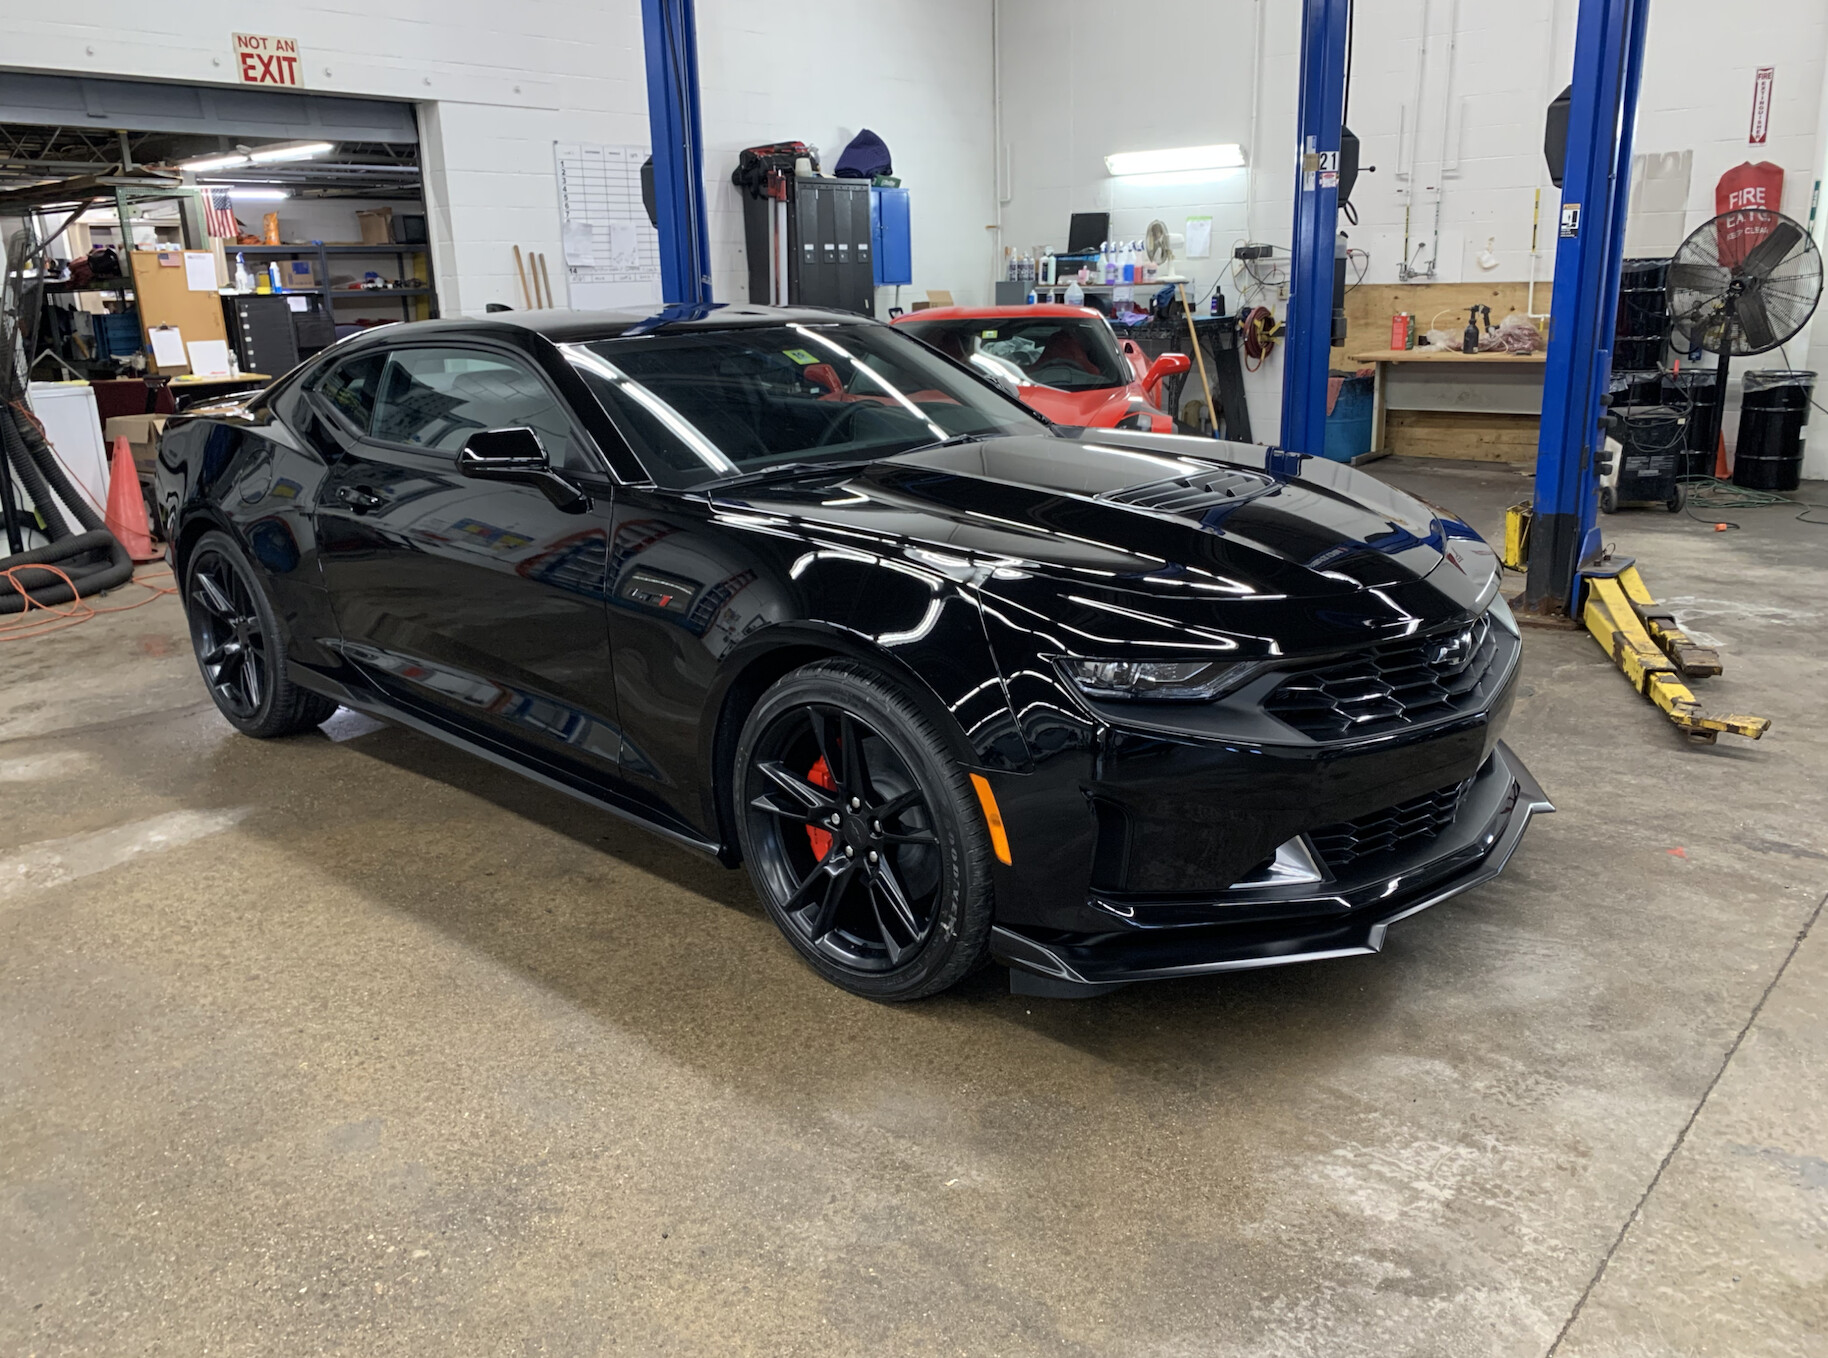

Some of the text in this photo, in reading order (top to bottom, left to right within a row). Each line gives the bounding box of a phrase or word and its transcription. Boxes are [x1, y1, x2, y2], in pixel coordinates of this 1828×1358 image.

[237, 35, 295, 53] NOT AN
[240, 52, 297, 85] EXIT
[1757, 72, 1772, 80] FIRE
[1320, 152, 1336, 170] 21
[1729, 187, 1766, 210] FIRE
